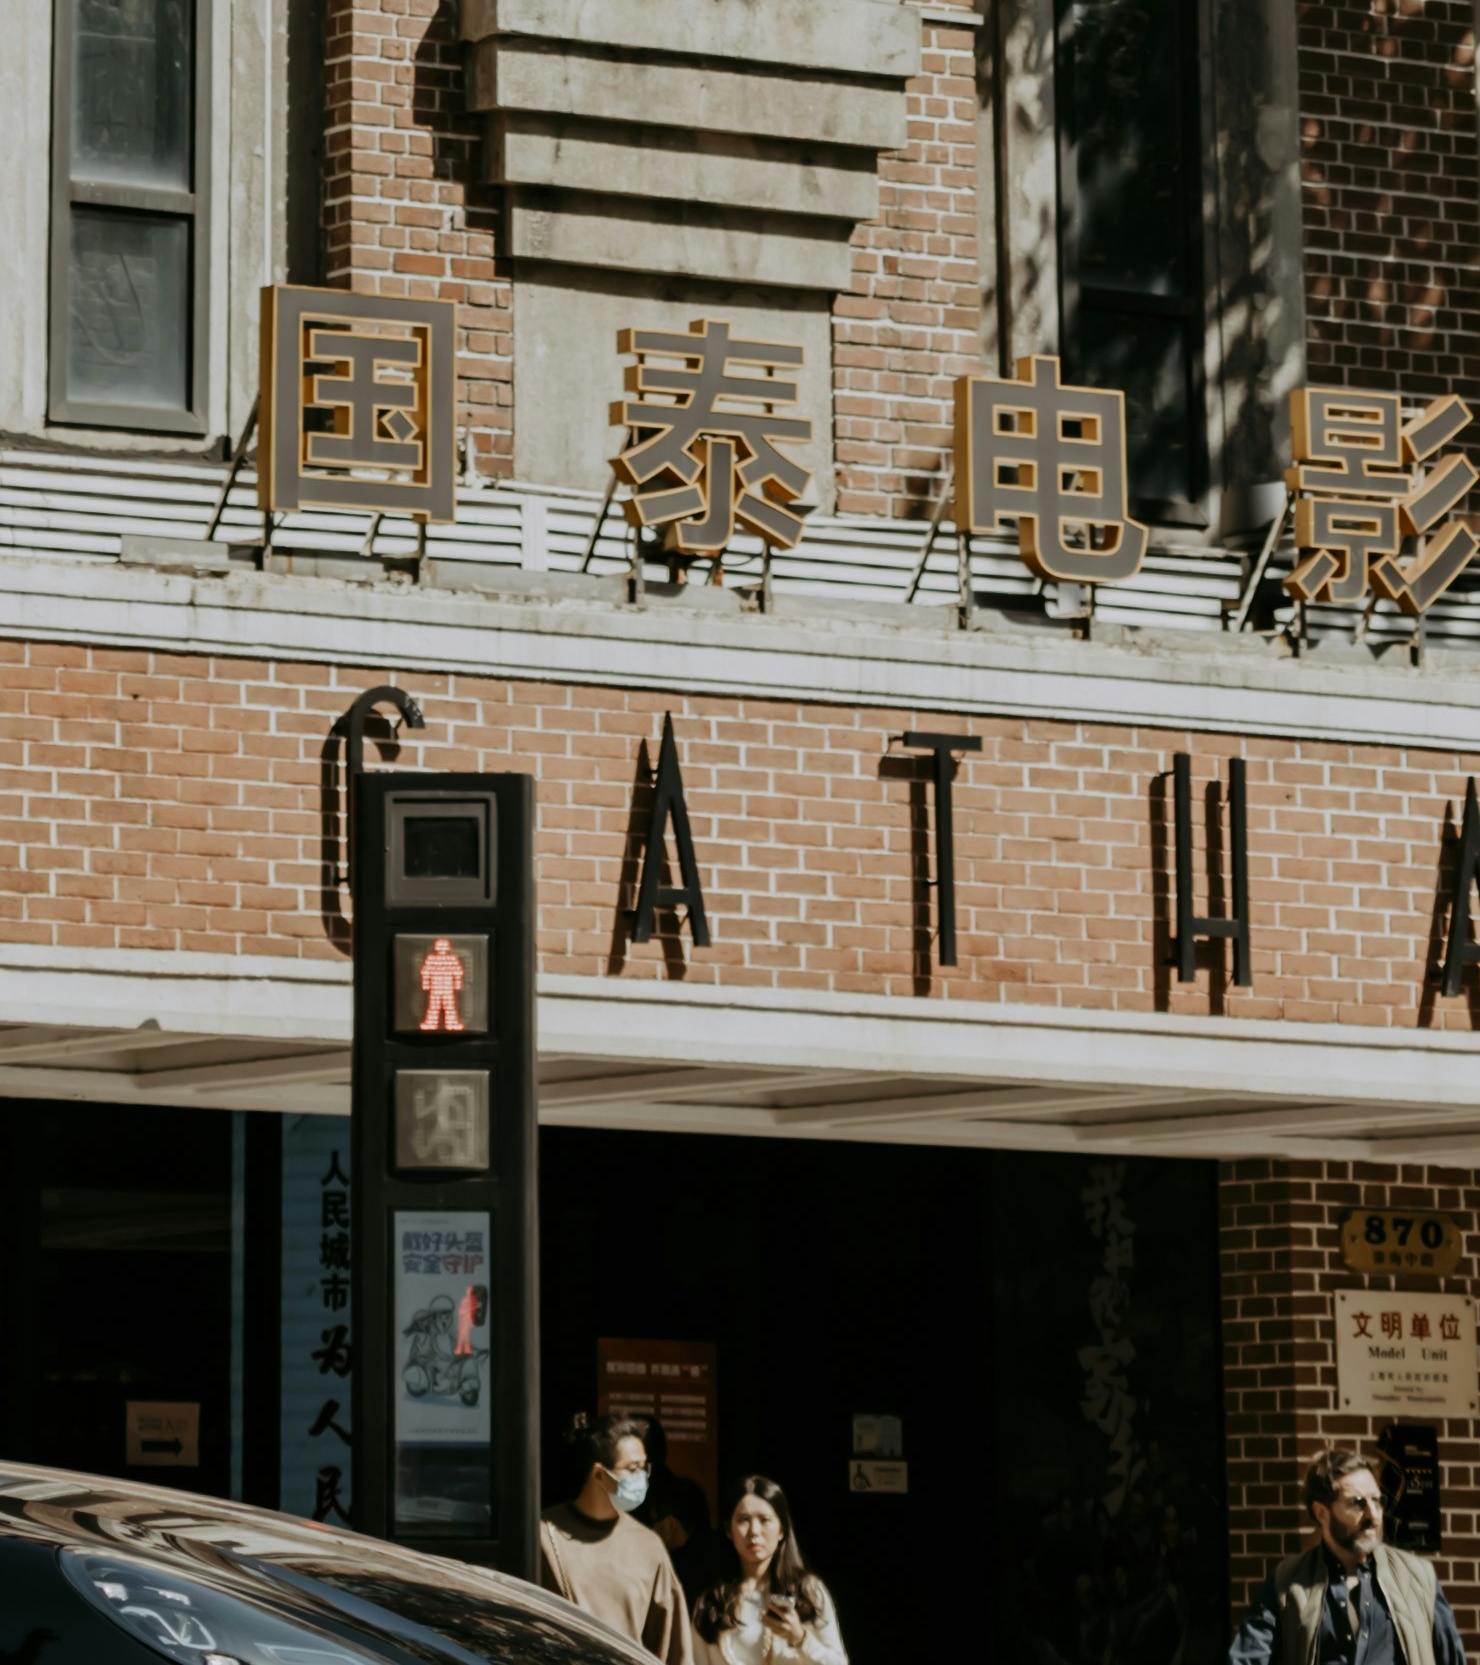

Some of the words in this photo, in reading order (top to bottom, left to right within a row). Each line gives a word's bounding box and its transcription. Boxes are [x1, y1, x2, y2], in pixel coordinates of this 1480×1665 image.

[402, 1231, 484, 1253] 戴好头盔
[1364, 1216, 1443, 1249] 870
[402, 1254, 484, 1274] 安全守护
[307, 1150, 351, 1522] 人民城市为人民
[1351, 1311, 1461, 1341] 文明单位
[1368, 1346, 1405, 1359] Model
[1421, 1348, 1448, 1361] Unit
